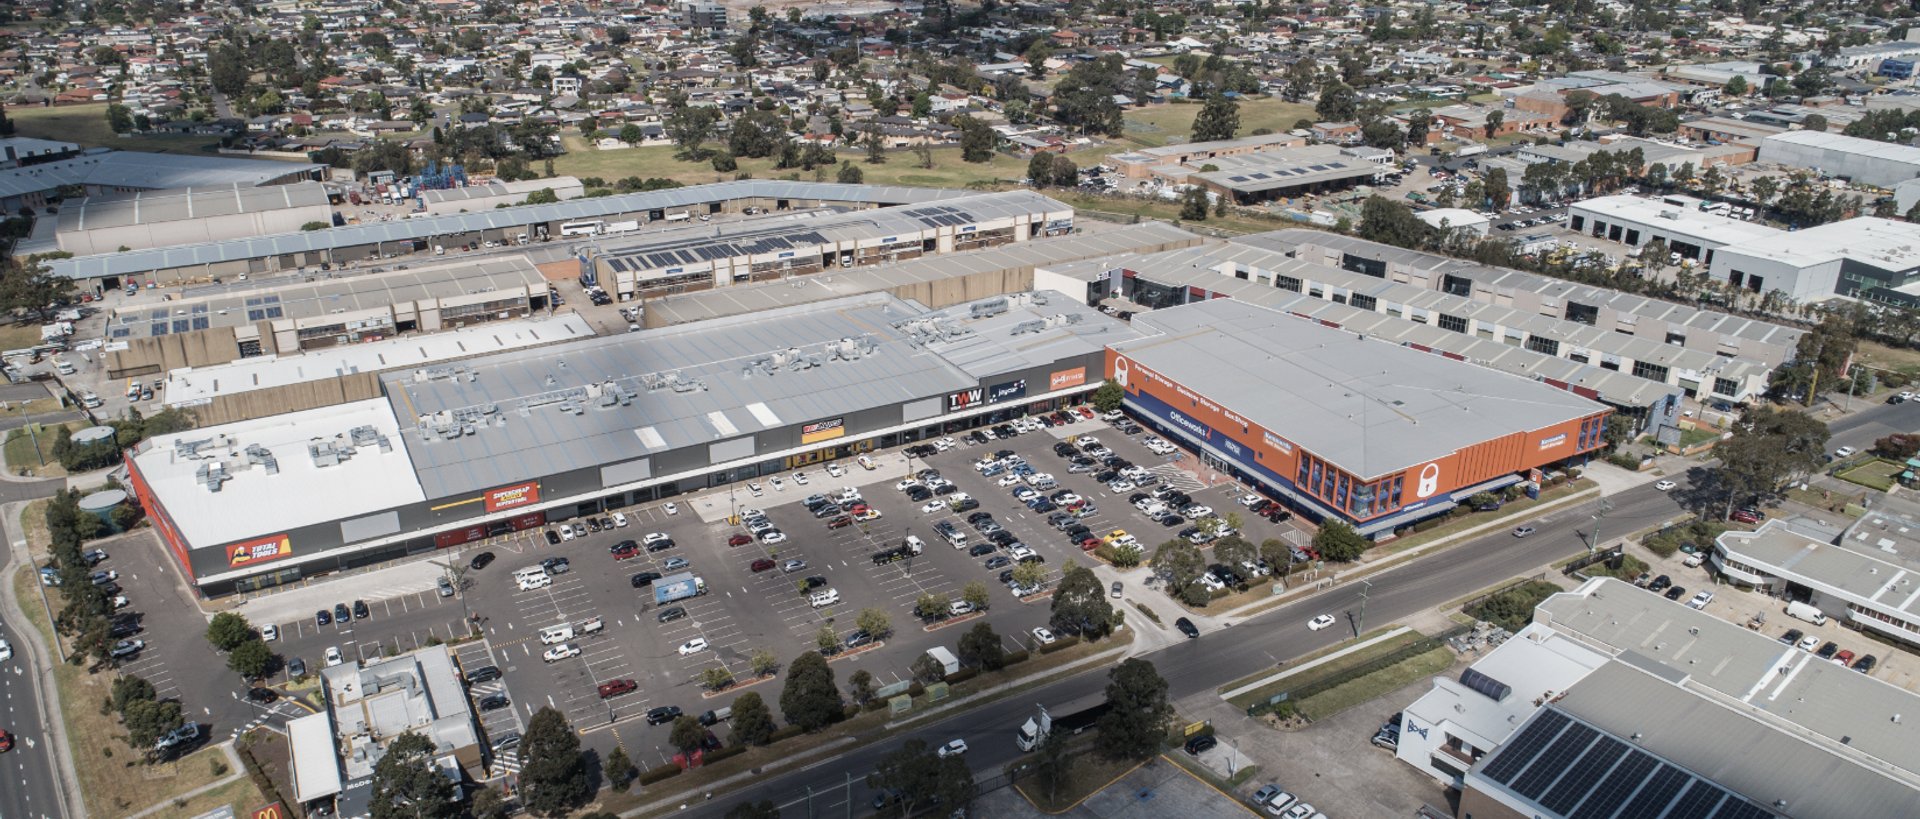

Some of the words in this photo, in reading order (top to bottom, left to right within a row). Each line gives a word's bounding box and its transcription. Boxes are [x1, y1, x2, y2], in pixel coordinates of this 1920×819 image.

[949, 388, 982, 406] TWW
[1154, 373, 1174, 388] Storage
[1200, 397, 1220, 412] Storage
[1169, 410, 1206, 437] Officeworks
[252, 542, 277, 553] TOTAL
[252, 547, 278, 559] TOOLS
